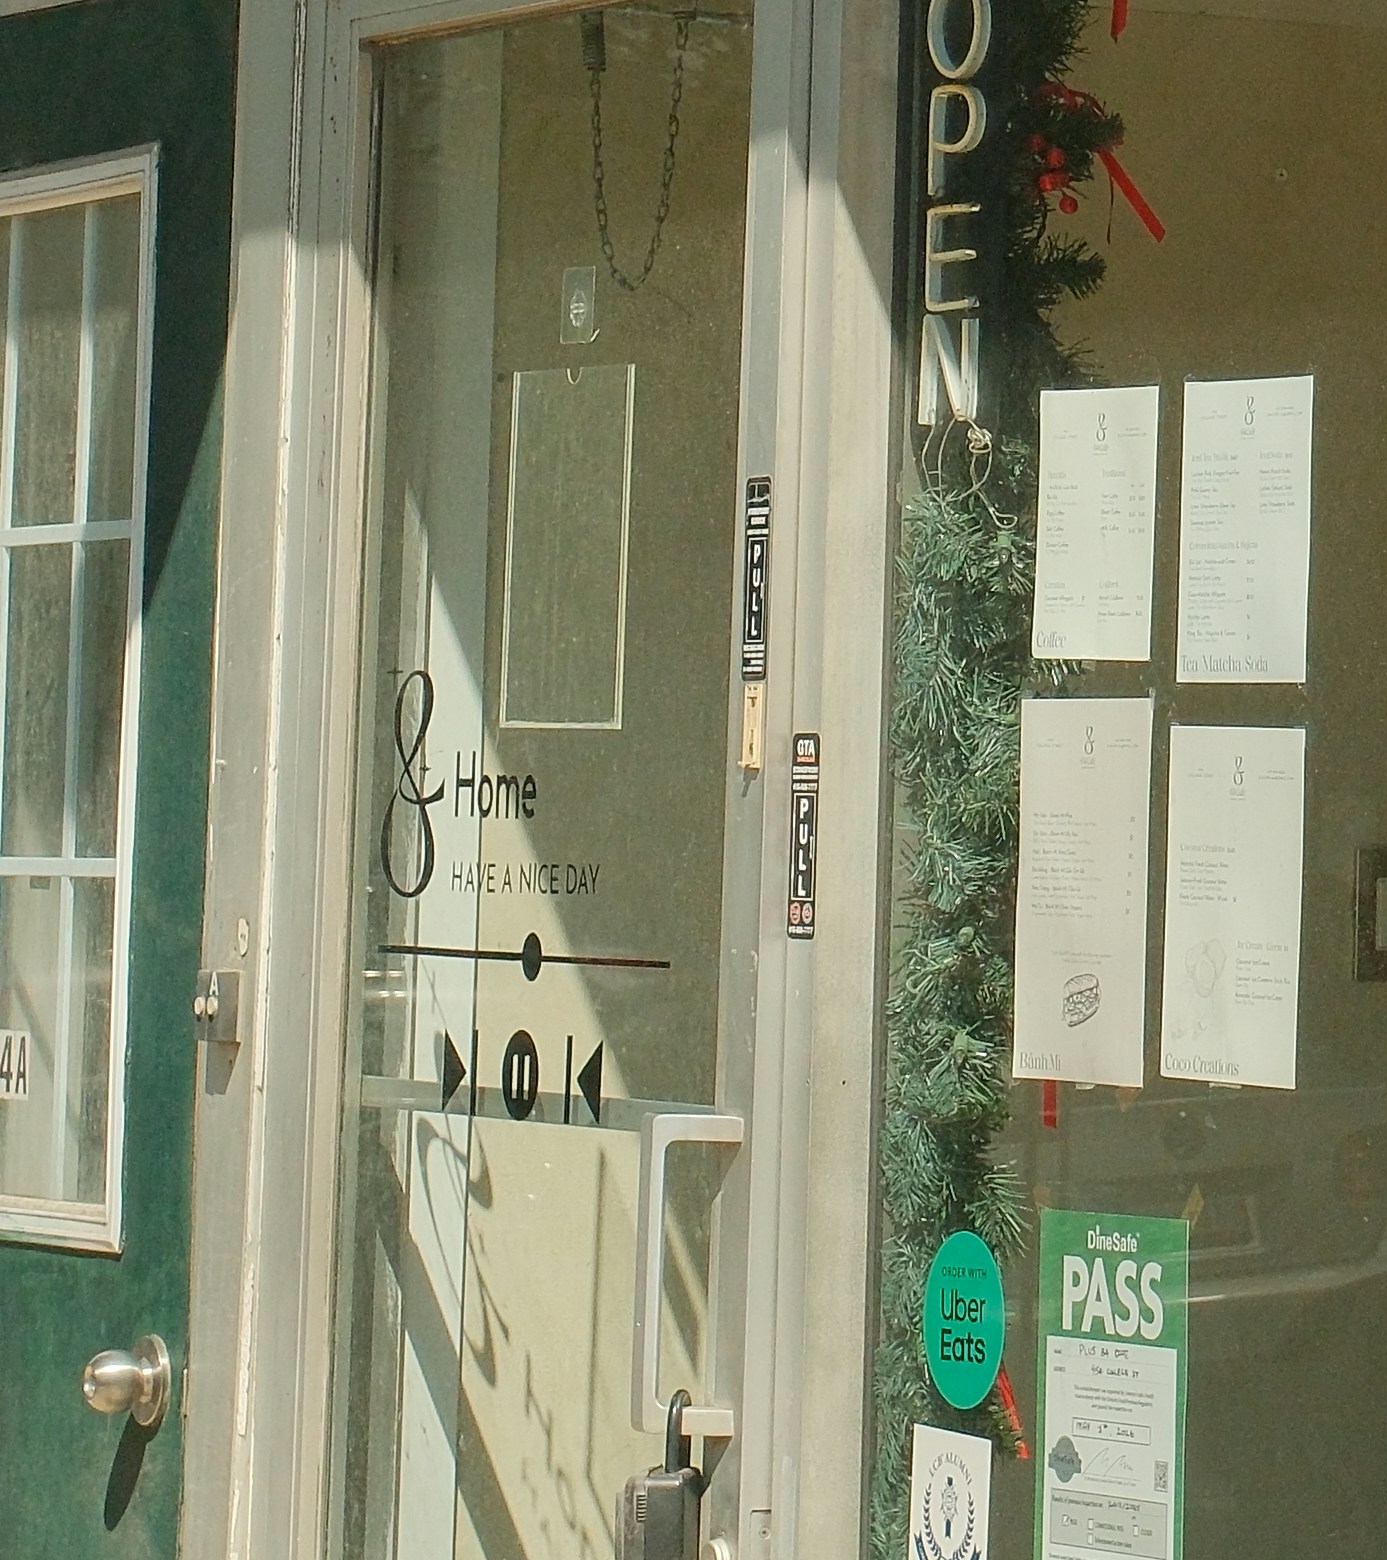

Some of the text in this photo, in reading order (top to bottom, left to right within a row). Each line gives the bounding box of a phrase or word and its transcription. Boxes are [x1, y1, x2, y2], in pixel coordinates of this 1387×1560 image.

[750, 543, 762, 637] PULL
[1036, 630, 1067, 649] Coffee
[1181, 655, 1268, 673] Tea Matcha Soda
[797, 739, 815, 758] GTA
[454, 750, 537, 819] Home
[798, 798, 809, 897] PULL
[451, 861, 600, 895] HAVE A NICE DAY
[209, 971, 219, 995] A
[1165, 1052, 1240, 1077] Coco Creations
[1087, 1224, 1139, 1253] DineSafe
[942, 1266, 987, 1279] ORDER WITH
[940, 1288, 986, 1324] Uber
[1062, 1255, 1164, 1340] PASS
[940, 1328, 986, 1365] Eats
